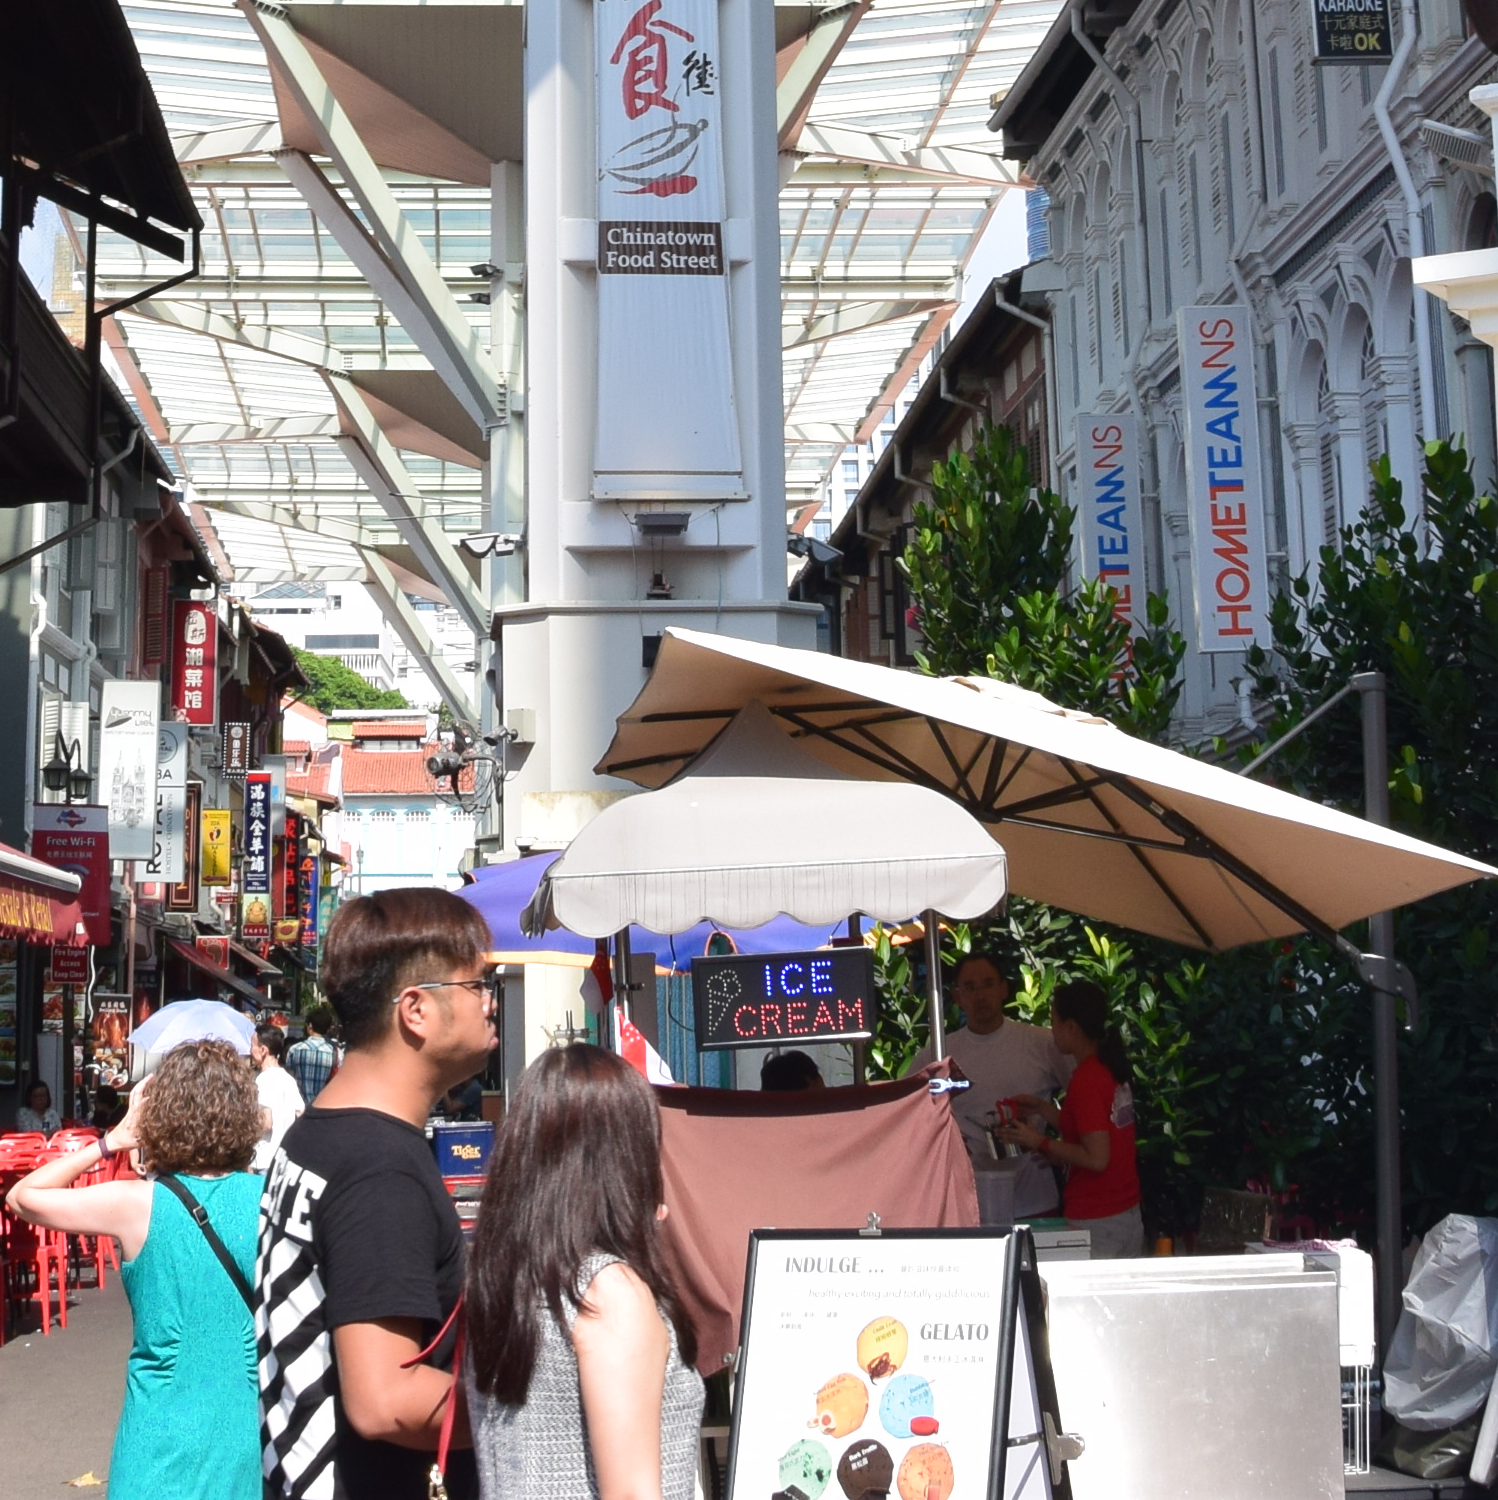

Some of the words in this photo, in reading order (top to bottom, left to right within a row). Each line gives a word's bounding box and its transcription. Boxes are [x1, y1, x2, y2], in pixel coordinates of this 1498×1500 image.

[1320, 14, 1385, 31] 十元家庭式
[607, 227, 716, 247] Chinatown
[605, 249, 654, 268] Food
[659, 251, 718, 270] Street
[46, 836, 69, 846] Free
[70, 836, 96, 847] Wi-Fi
[67, 948, 86, 958] Engine
[59, 959, 81, 968] Access
[54, 970, 69, 979] Keep
[69, 970, 86, 978] Clear
[764, 960, 834, 997] ICE
[733, 997, 864, 1037] CREAM
[450, 1144, 482, 1157] Tiger
[785, 1257, 862, 1274] INDULGE
[809, 1288, 842, 1301] healthy
[844, 1288, 881, 1301] exciting
[883, 1288, 901, 1299] and
[903, 1288, 934, 1300] totally
[919, 1323, 990, 1341] GELATO
